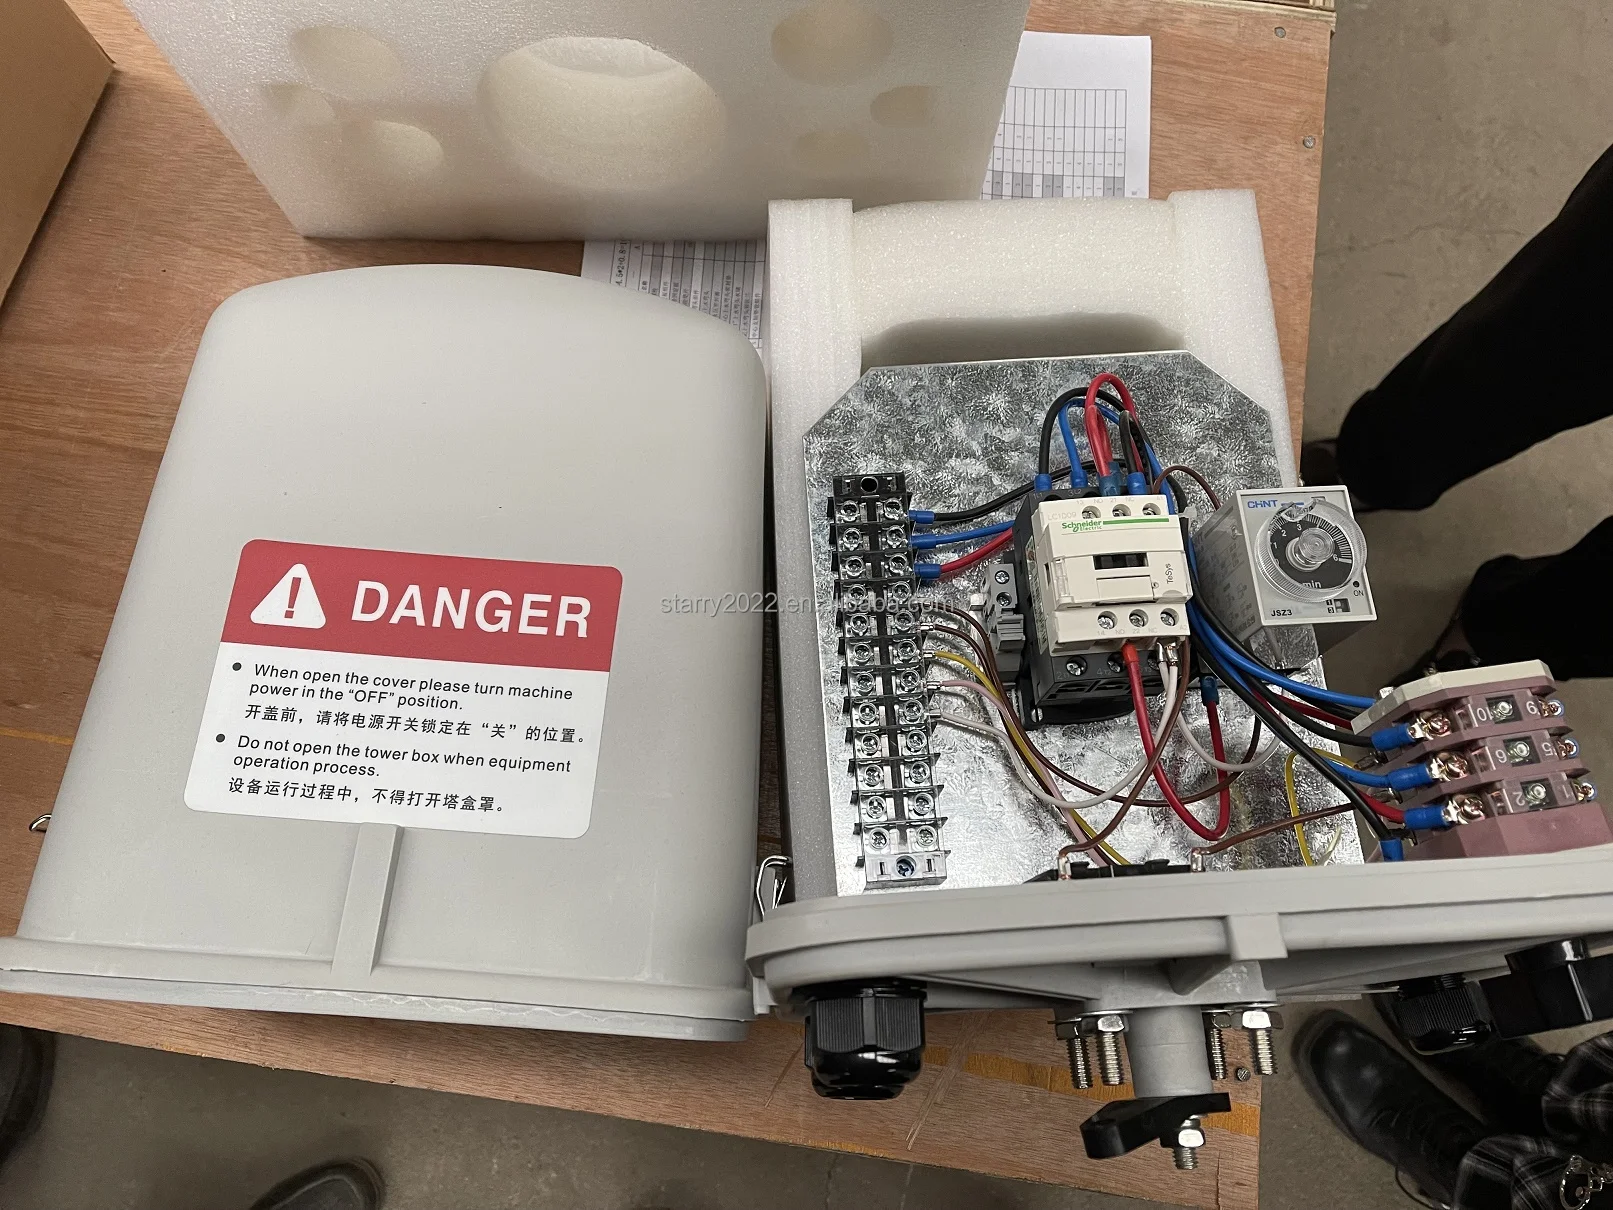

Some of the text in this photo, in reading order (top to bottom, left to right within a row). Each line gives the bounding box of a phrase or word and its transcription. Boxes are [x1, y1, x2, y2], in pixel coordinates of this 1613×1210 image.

[1061, 519, 1102, 532] Schneider
[1165, 563, 1174, 584] TeSys
[352, 580, 592, 638] DANGER
[1271, 609, 1292, 617] JSZ3
[255, 663, 573, 700] When open the cover please turn machine
[249, 683, 299, 697] power
[301, 685, 315, 699] in
[319, 687, 344, 701] the
[397, 695, 463, 710] position.
[233, 755, 380, 777] operation process.
[237, 735, 572, 773] Do not open the tower box when equipment
